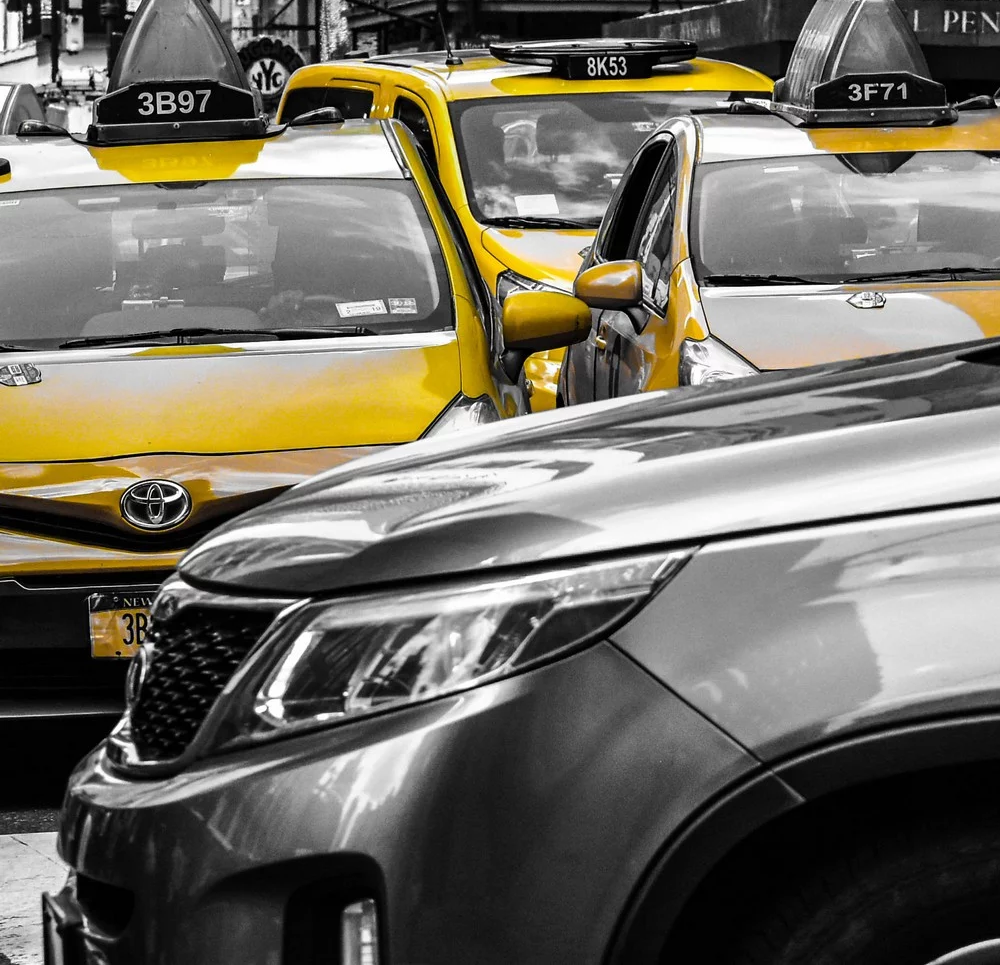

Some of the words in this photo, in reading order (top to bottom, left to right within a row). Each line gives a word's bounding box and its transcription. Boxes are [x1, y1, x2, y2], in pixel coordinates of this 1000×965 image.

[252, 61, 283, 91] NYC
[587, 56, 628, 77] 8K53
[137, 90, 211, 116] 3B97
[848, 82, 907, 101] 3F71
[123, 597, 152, 607] NEW
[122, 613, 151, 645] 3B
